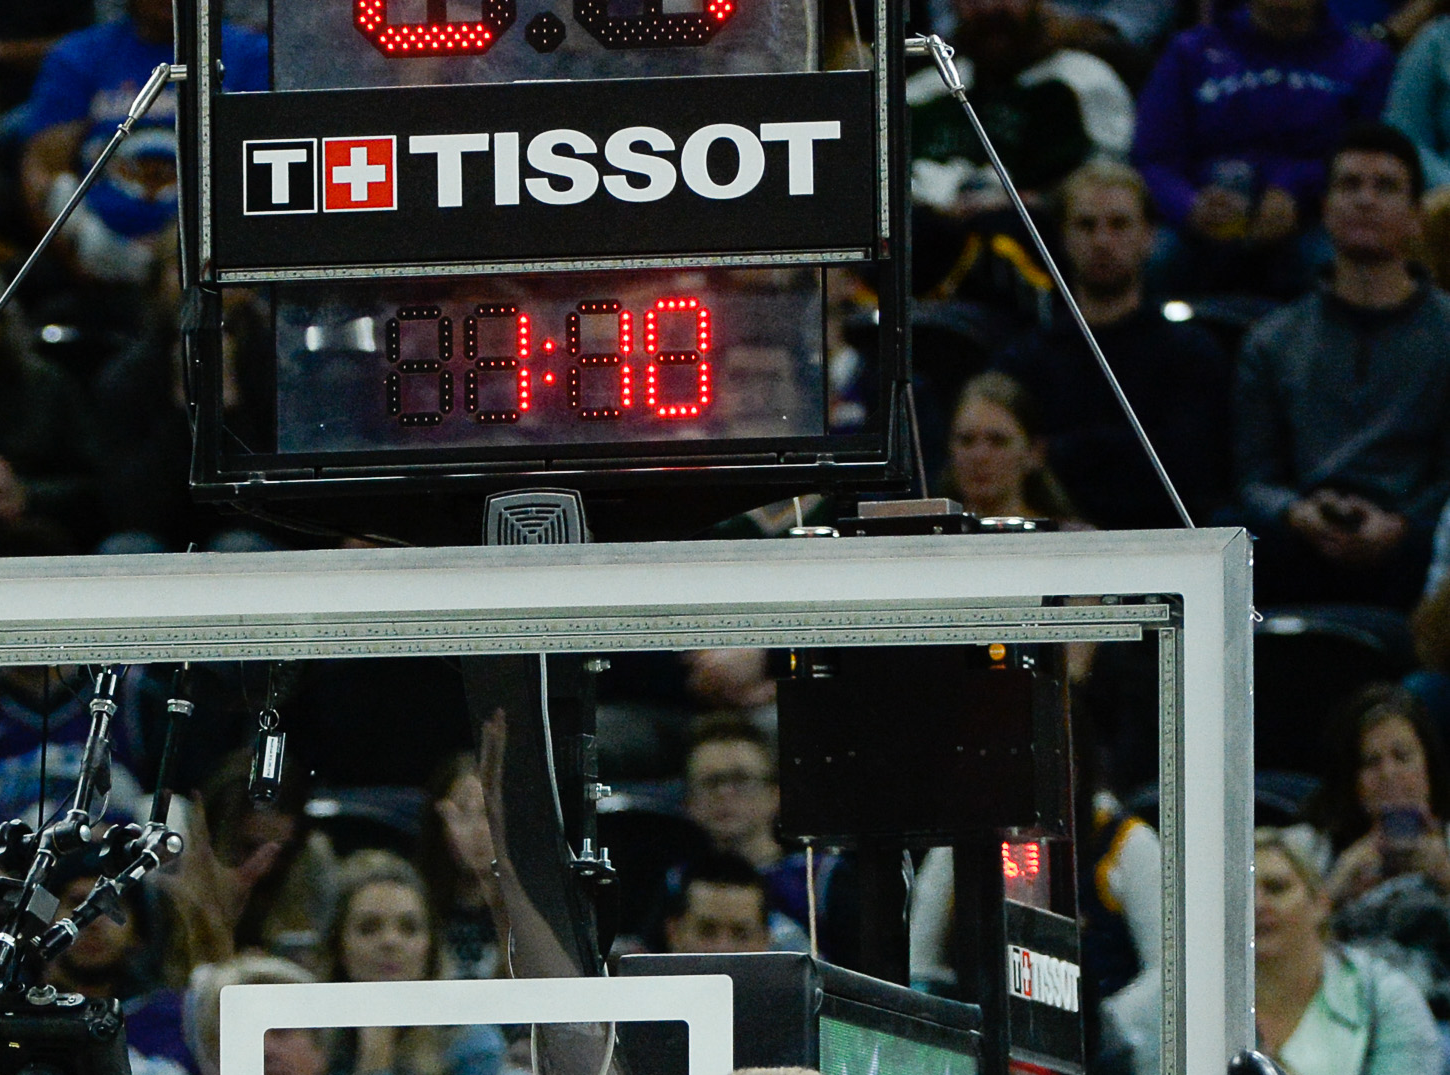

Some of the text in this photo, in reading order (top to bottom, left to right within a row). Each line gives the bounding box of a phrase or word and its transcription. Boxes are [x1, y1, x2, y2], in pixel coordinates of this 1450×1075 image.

[409, 121, 841, 208] TISSOT
[517, 297, 712, 419] 1:10
[1030, 952, 1081, 1013] TISSOT
